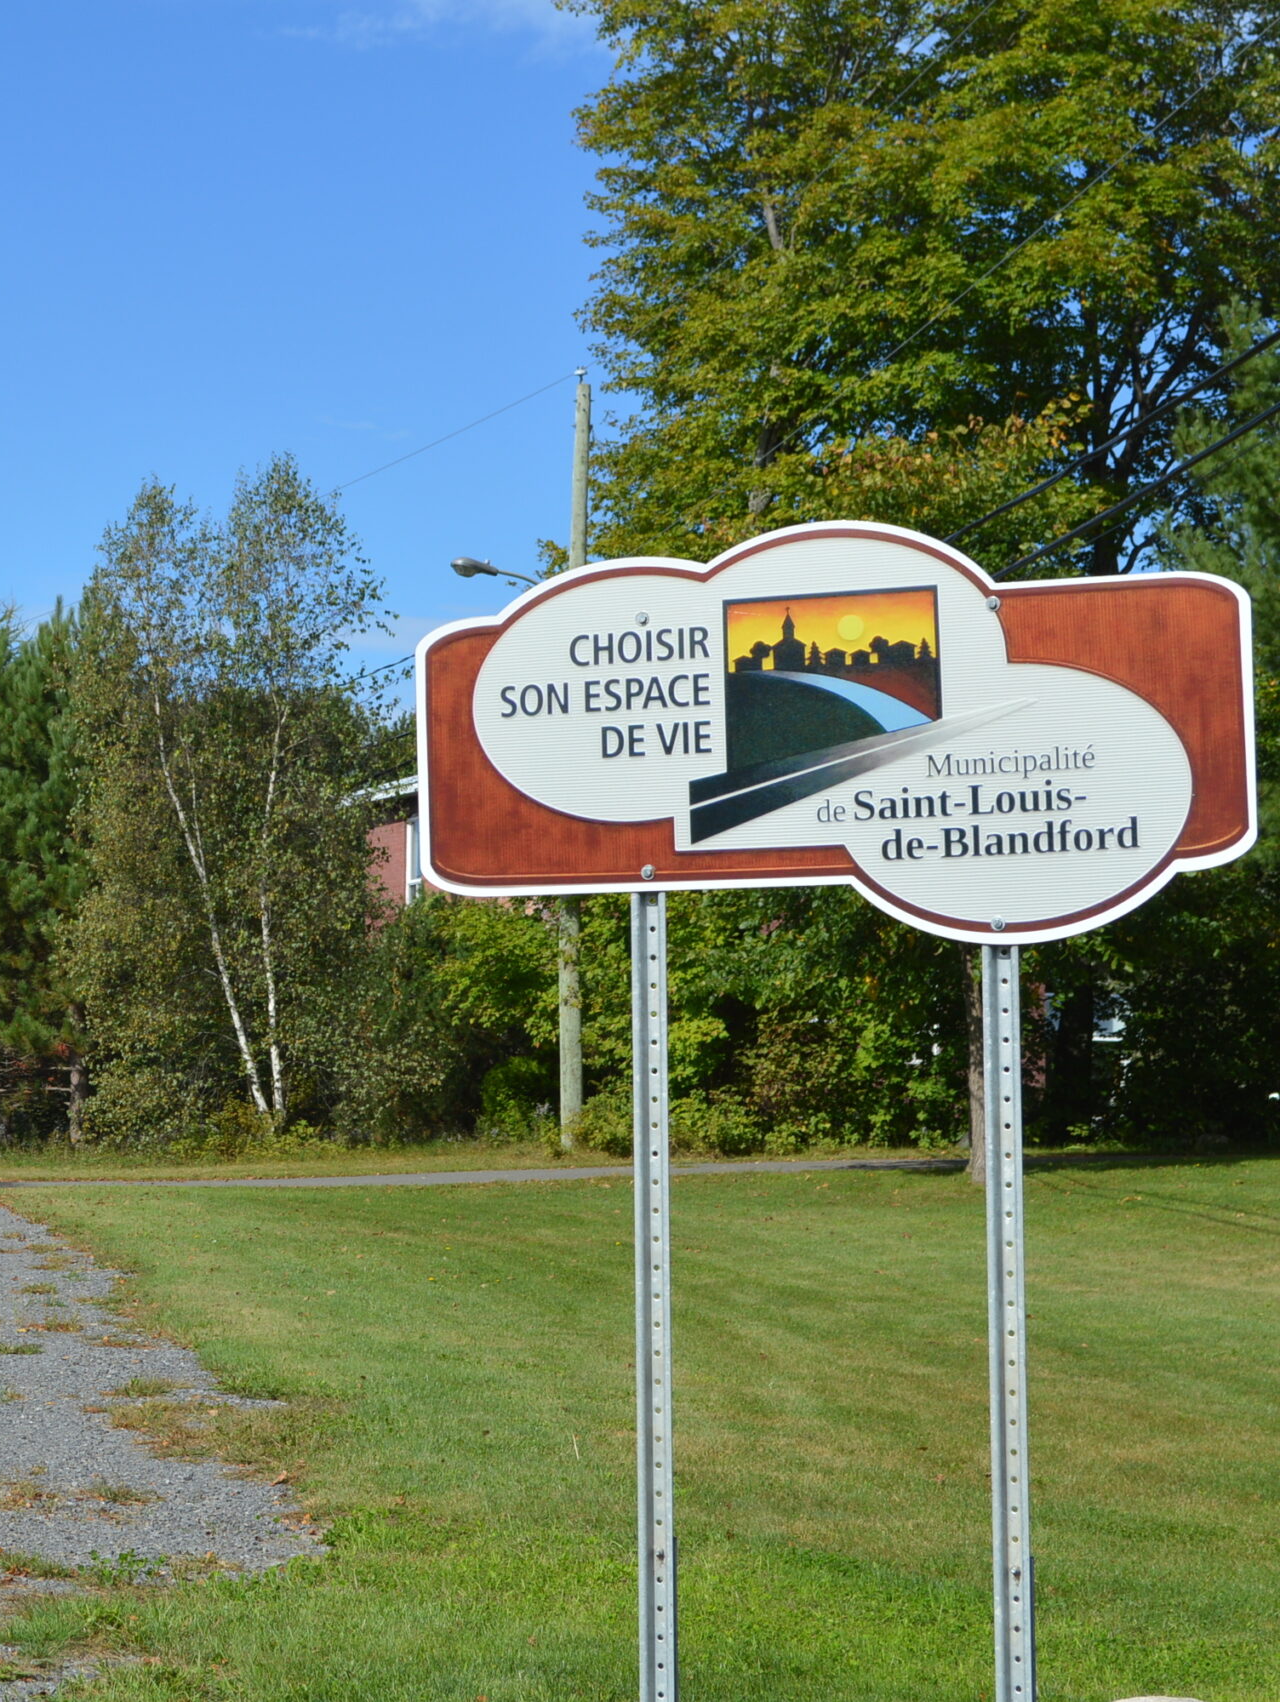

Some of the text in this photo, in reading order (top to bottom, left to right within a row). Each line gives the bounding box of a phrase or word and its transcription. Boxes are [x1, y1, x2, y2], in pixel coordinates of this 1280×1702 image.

[569, 626, 710, 667] CHOISIR
[500, 673, 711, 718] SON ESPACE
[601, 720, 712, 759] DE VIE
[925, 744, 1096, 779] Municipalité
[816, 779, 1088, 823] de Saint-Louis-
[881, 815, 1141, 861] de-Blandford
